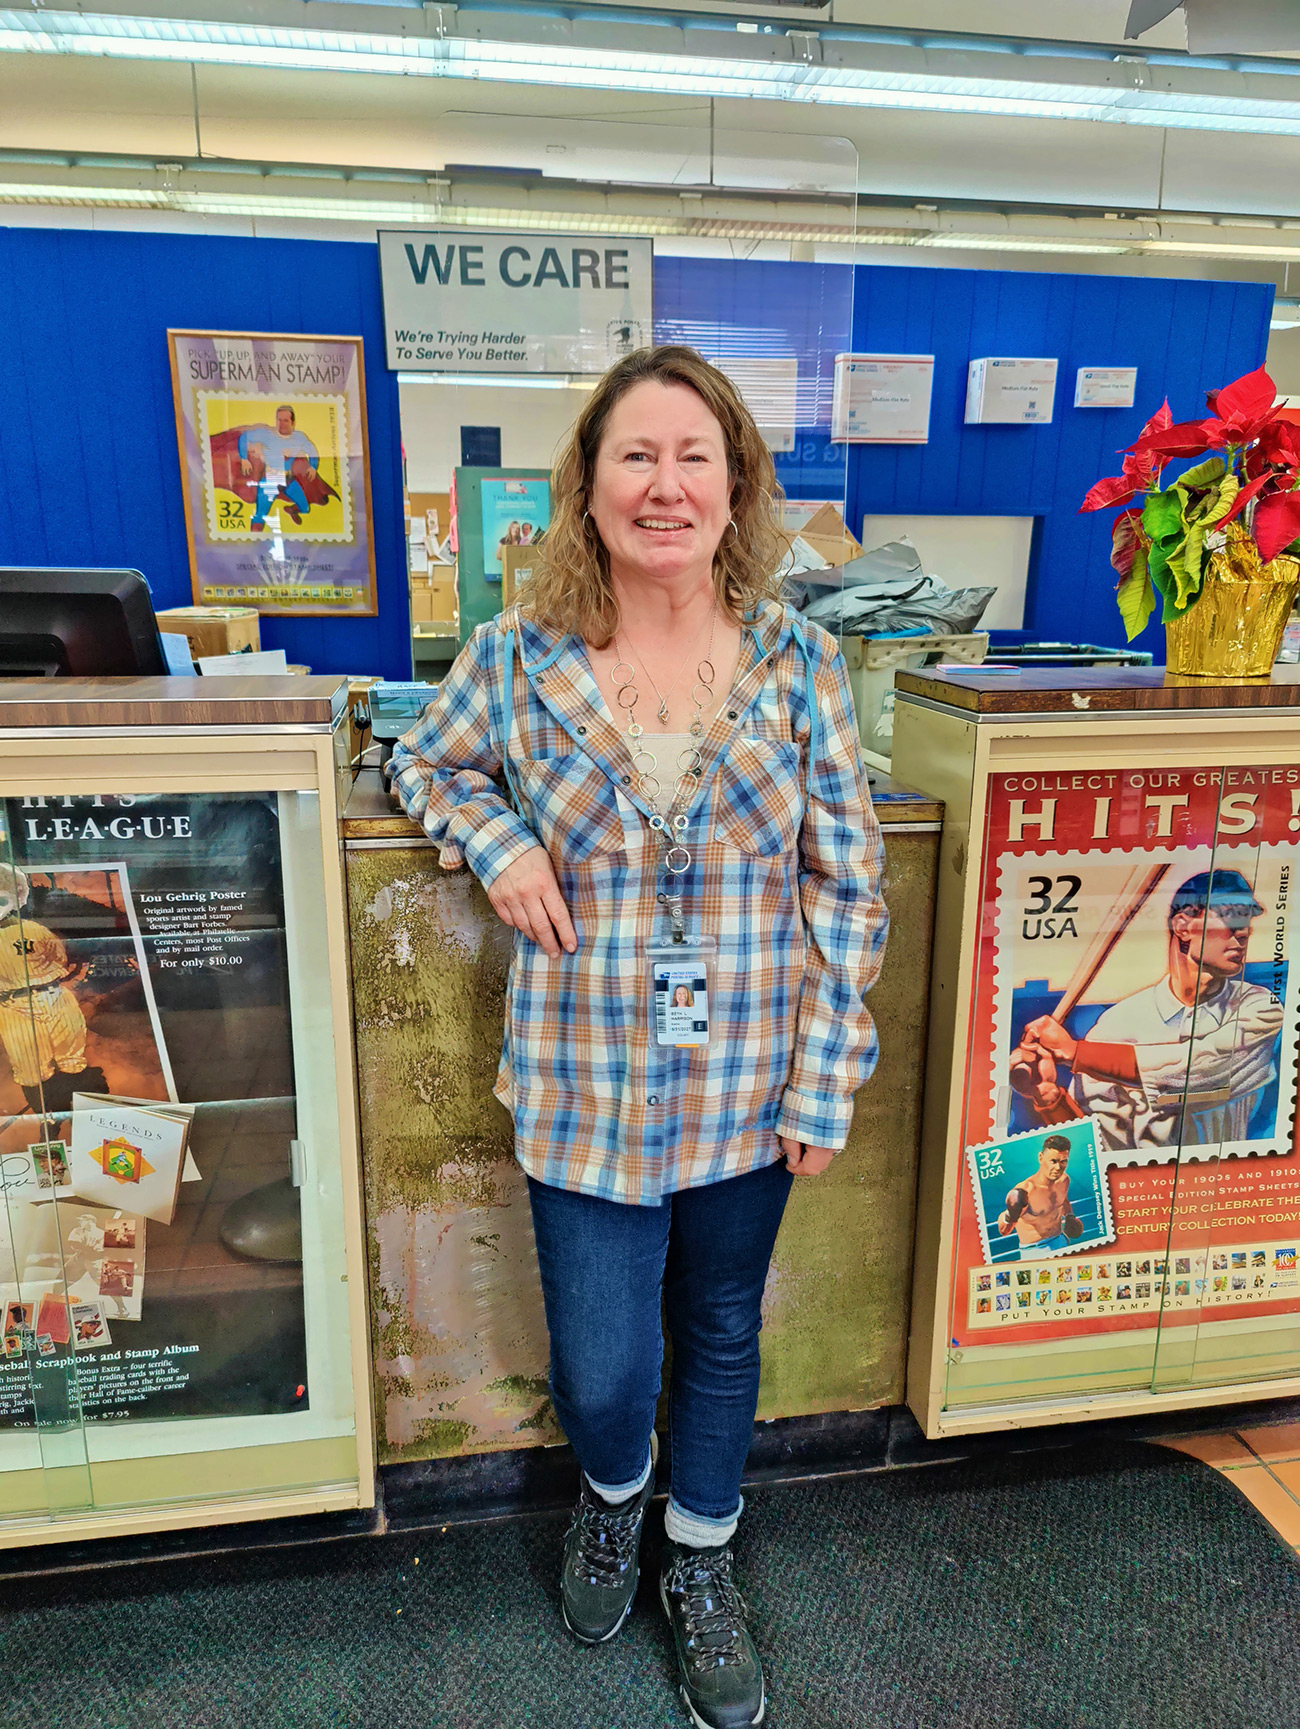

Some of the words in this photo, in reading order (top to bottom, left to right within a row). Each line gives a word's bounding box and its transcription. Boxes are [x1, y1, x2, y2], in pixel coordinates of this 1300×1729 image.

[404, 243, 486, 286] WE
[498, 246, 630, 289] CARE
[394, 330, 434, 343] We're
[437, 331, 478, 347] Trying
[481, 331, 526, 345] Harder
[187, 349, 211, 358] PICK
[255, 352, 276, 361] AND
[316, 354, 345, 363] YOUR
[395, 347, 413, 360] To
[415, 347, 454, 360] Serve
[457, 348, 483, 361] You
[485, 348, 529, 361] Better.
[190, 360, 281, 381] SUPERMAN
[286, 364, 346, 384] STAMP!
[219, 500, 245, 518] 32
[219, 519, 246, 529] USA
[1003, 775, 1118, 792] COLLECT
[1129, 773, 1182, 788] OUR
[1024, 874, 1082, 915] 32
[1276, 865, 1290, 910] SERIES
[140, 894, 162, 903] Lou
[166, 892, 207, 902] Gehrig
[210, 891, 247, 900] Poster
[144, 906, 174, 915] Original
[208, 905, 218, 913] by
[146, 914, 169, 924] sports
[209, 914, 231, 922] stamp
[149, 923, 181, 932] designer
[1021, 917, 1078, 940] USA
[156, 946, 170, 954] and
[172, 946, 182, 954] by
[202, 944, 224, 952] order.
[1273, 916, 1286, 967] WORLD
[160, 959, 178, 968] For
[182, 958, 204, 968] only
[208, 956, 243, 966] $10.00
[90, 1115, 162, 1140] LEGENDS
[978, 1148, 1003, 1170] 32
[980, 1165, 1005, 1180] USA
[1119, 1181, 1145, 1190] BUY
[1152, 1178, 1186, 1187] YOUR
[1237, 1172, 1263, 1180] AND
[1118, 1194, 1164, 1203] SPECIAL
[1170, 1190, 1215, 1199] EDITION
[1218, 1186, 1254, 1194] STAMP
[1258, 1182, 1300, 1191] SHEETS
[1117, 1208, 1158, 1218] START
[1161, 1205, 1198, 1215] YOUR
[1200, 1198, 1274, 1213] CELEBRATE
[1276, 1195, 1300, 1205] THE
[1116, 1223, 1177, 1235] CENTURY
[1178, 1216, 1256, 1231] COLLECTION
[1001, 1312, 1030, 1321] PUT
[1042, 1308, 1085, 1316] YOUR
[1097, 1302, 1150, 1313] STAMP
[1162, 1300, 1183, 1308] ON
[1196, 1290, 1272, 1305] HISTORY!
[36, 1353, 97, 1369] Scrapbook
[100, 1351, 122, 1360] and
[125, 1348, 160, 1359] Stamp
[163, 1344, 200, 1355] Album
[77, 1368, 99, 1376] Bonus
[130, 1362, 146, 1370] four
[148, 1360, 172, 1368] terrific
[100, 1373, 125, 1381] trading
[128, 1370, 146, 1378] cards
[148, 1368, 165, 1376] with
[98, 1382, 128, 1390] pictures
[116, 1385, 162, 1395] Fame-caliber
[164, 1382, 186, 1390] career
[68, 1398, 100, 1409] staistics
[102, 1410, 130, 1419] $7.95
